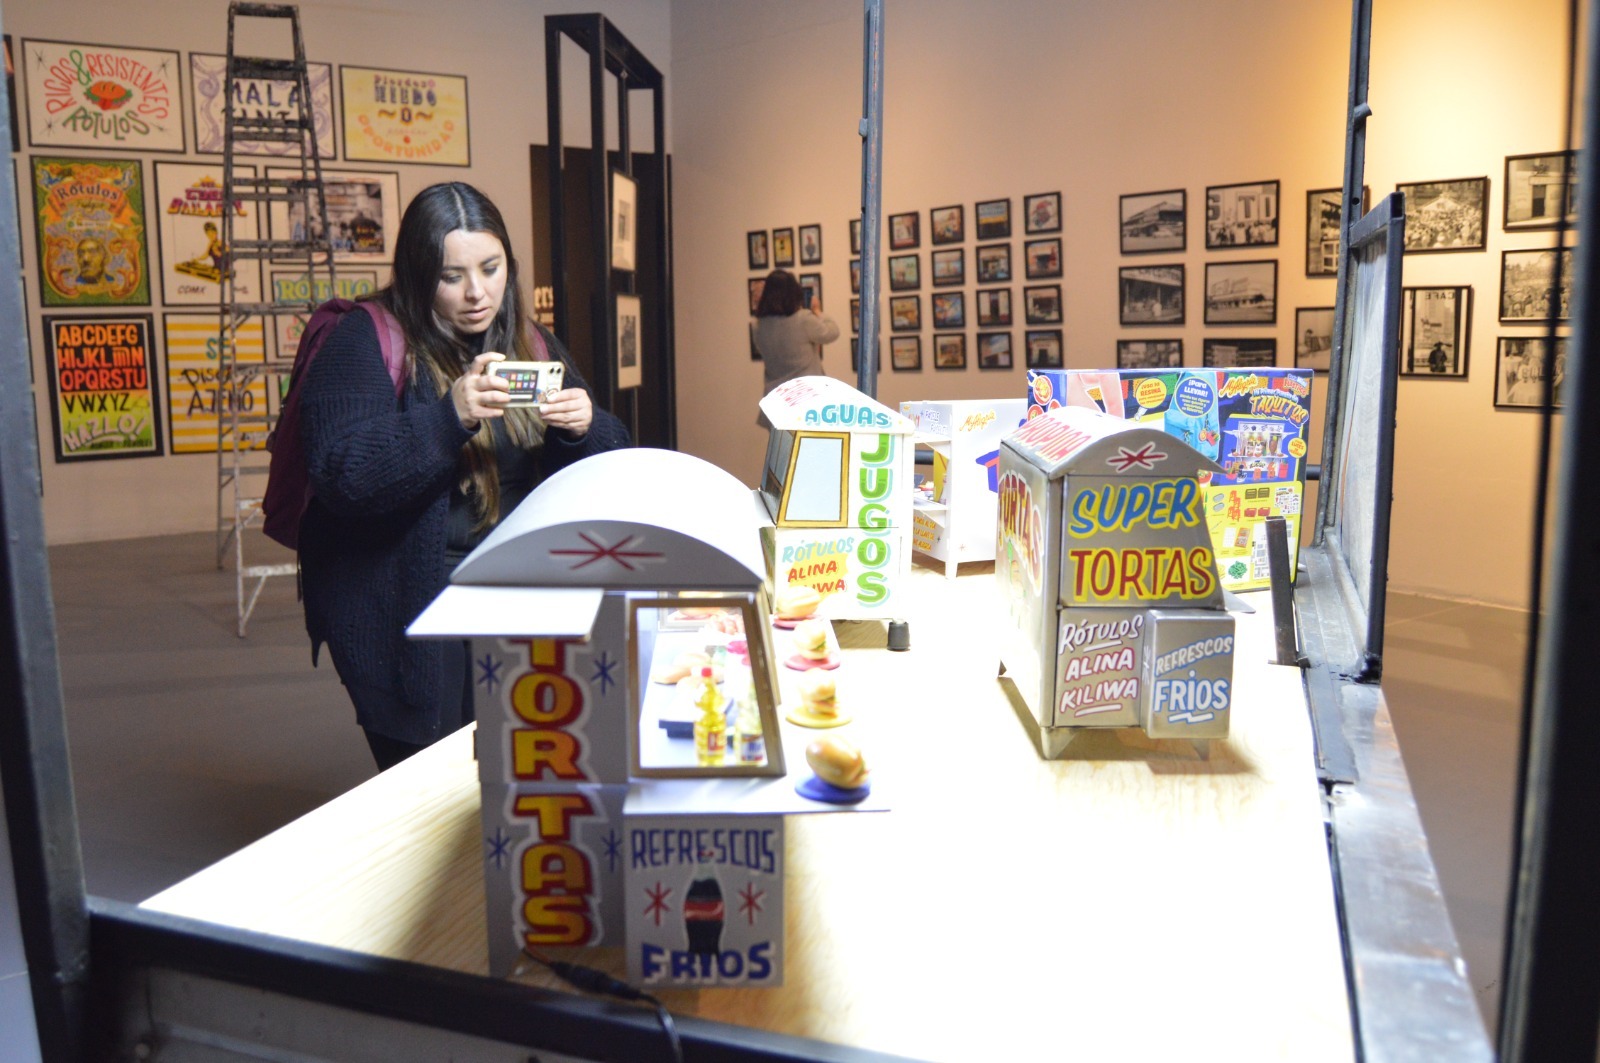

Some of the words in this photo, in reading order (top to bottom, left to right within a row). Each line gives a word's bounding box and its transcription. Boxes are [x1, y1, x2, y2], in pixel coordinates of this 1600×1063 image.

[44, 57, 79, 114] RICOS
[69, 49, 92, 86] &
[85, 53, 169, 119] RESISTENTES
[58, 324, 139, 347] ABCDEFG
[57, 345, 145, 370] HIJKLMN
[60, 367, 147, 391] OPQRSTU
[804, 403, 892, 428] AGUAS
[1250, 394, 1309, 424] TAQUITOS
[63, 414, 148, 452] HAZLO!
[857, 433, 893, 606] JUGOS
[1069, 477, 1200, 539] SUPER
[782, 537, 855, 563] RÓTULOS
[787, 560, 838, 583] ALINA
[1070, 547, 1216, 601] TORTAS
[1059, 614, 1143, 654] RÓTULOS
[1064, 647, 1135, 682] ALINA
[1155, 635, 1233, 676] REFRESCOS
[1060, 677, 1138, 713] KILIWA
[508, 638, 597, 947] TORTAS
[631, 828, 776, 875] REFRESCOS
[641, 940, 772, 981] FRIOS
